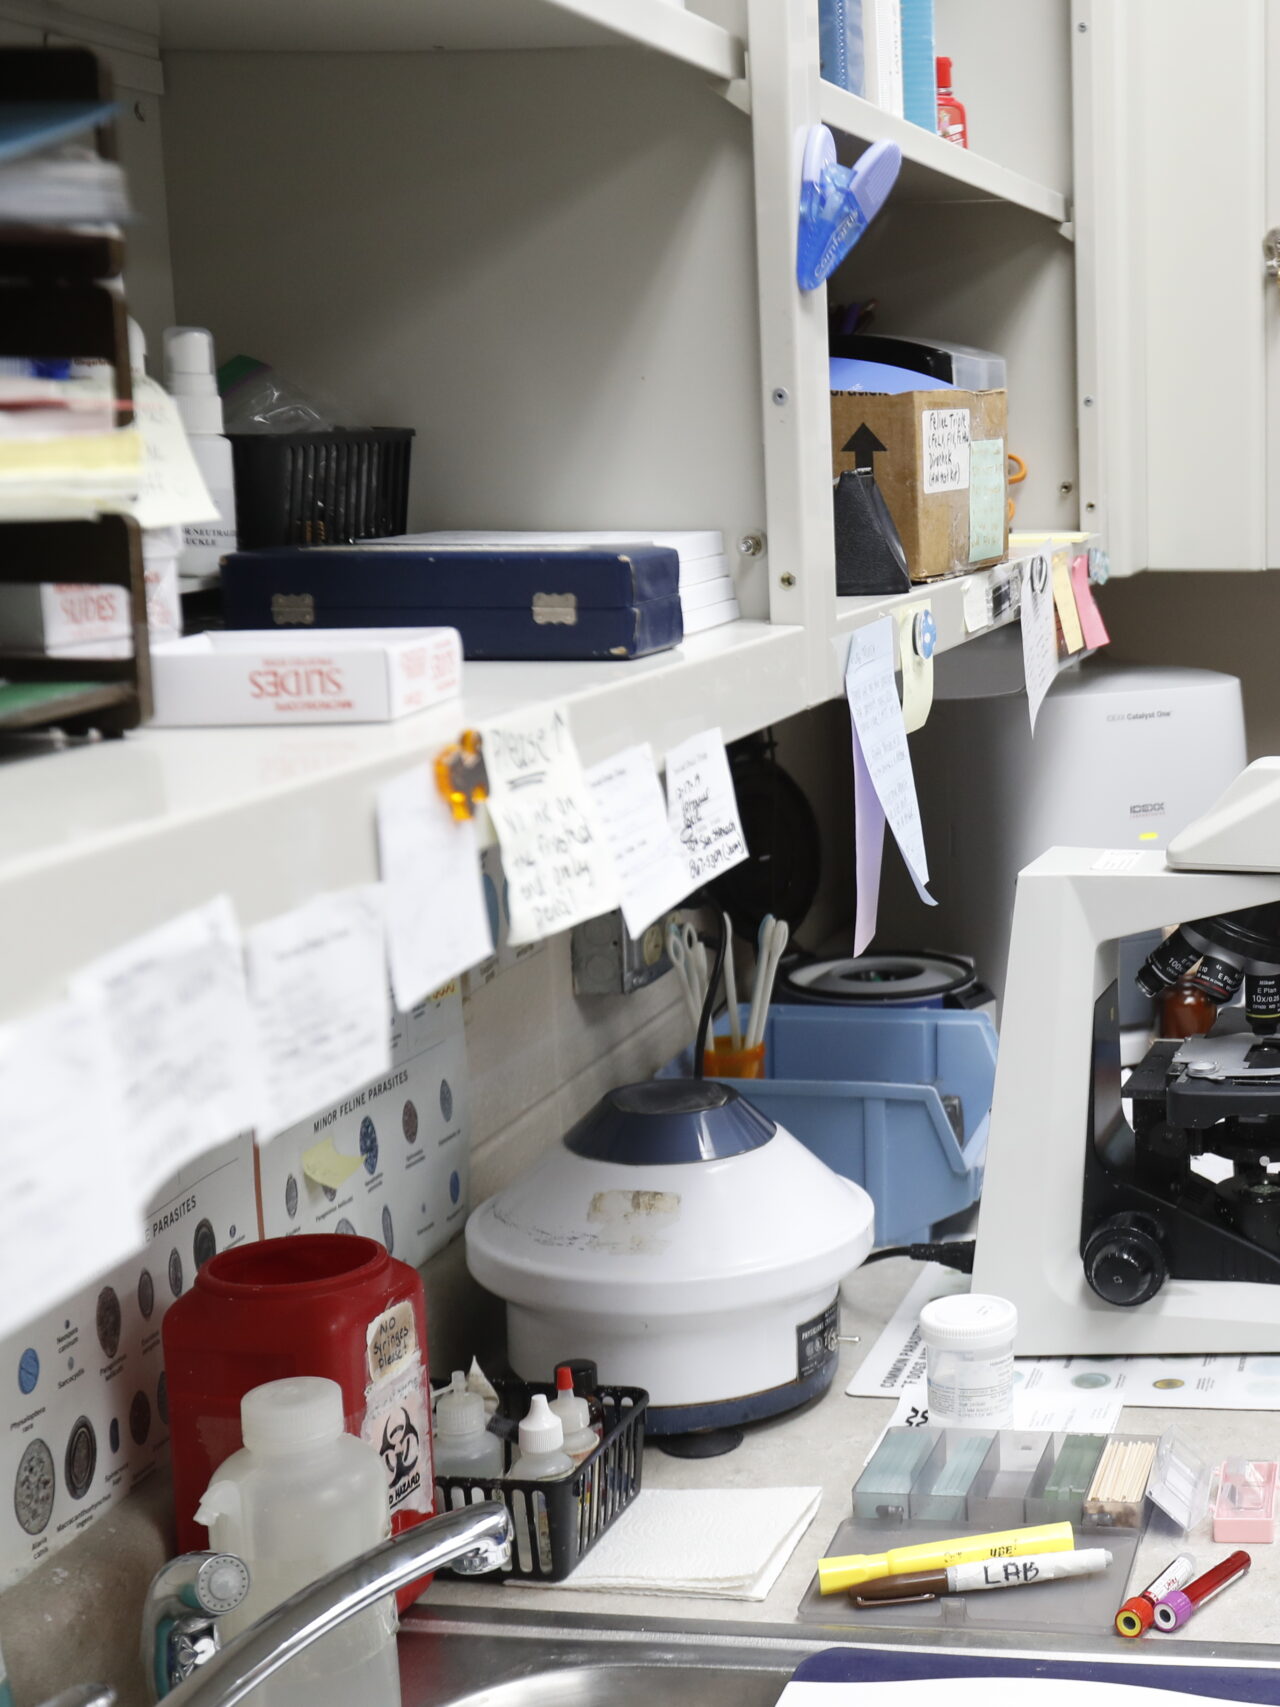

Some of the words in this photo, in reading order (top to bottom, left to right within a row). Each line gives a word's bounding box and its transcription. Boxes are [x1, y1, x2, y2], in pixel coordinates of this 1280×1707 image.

[1127, 711, 1155, 720] Catalyst
[313, 1110, 337, 1133] MINOR
[340, 1093, 366, 1117] FELINE
[368, 1070, 409, 1100] PARASITES
[153, 1195, 197, 1237] PARASITES
[380, 1316, 396, 1334] NO
[880, 1358, 910, 1388] COMMON
[395, 1473, 421, 1501] HAZARD
[983, 1562, 1039, 1585] LAB
